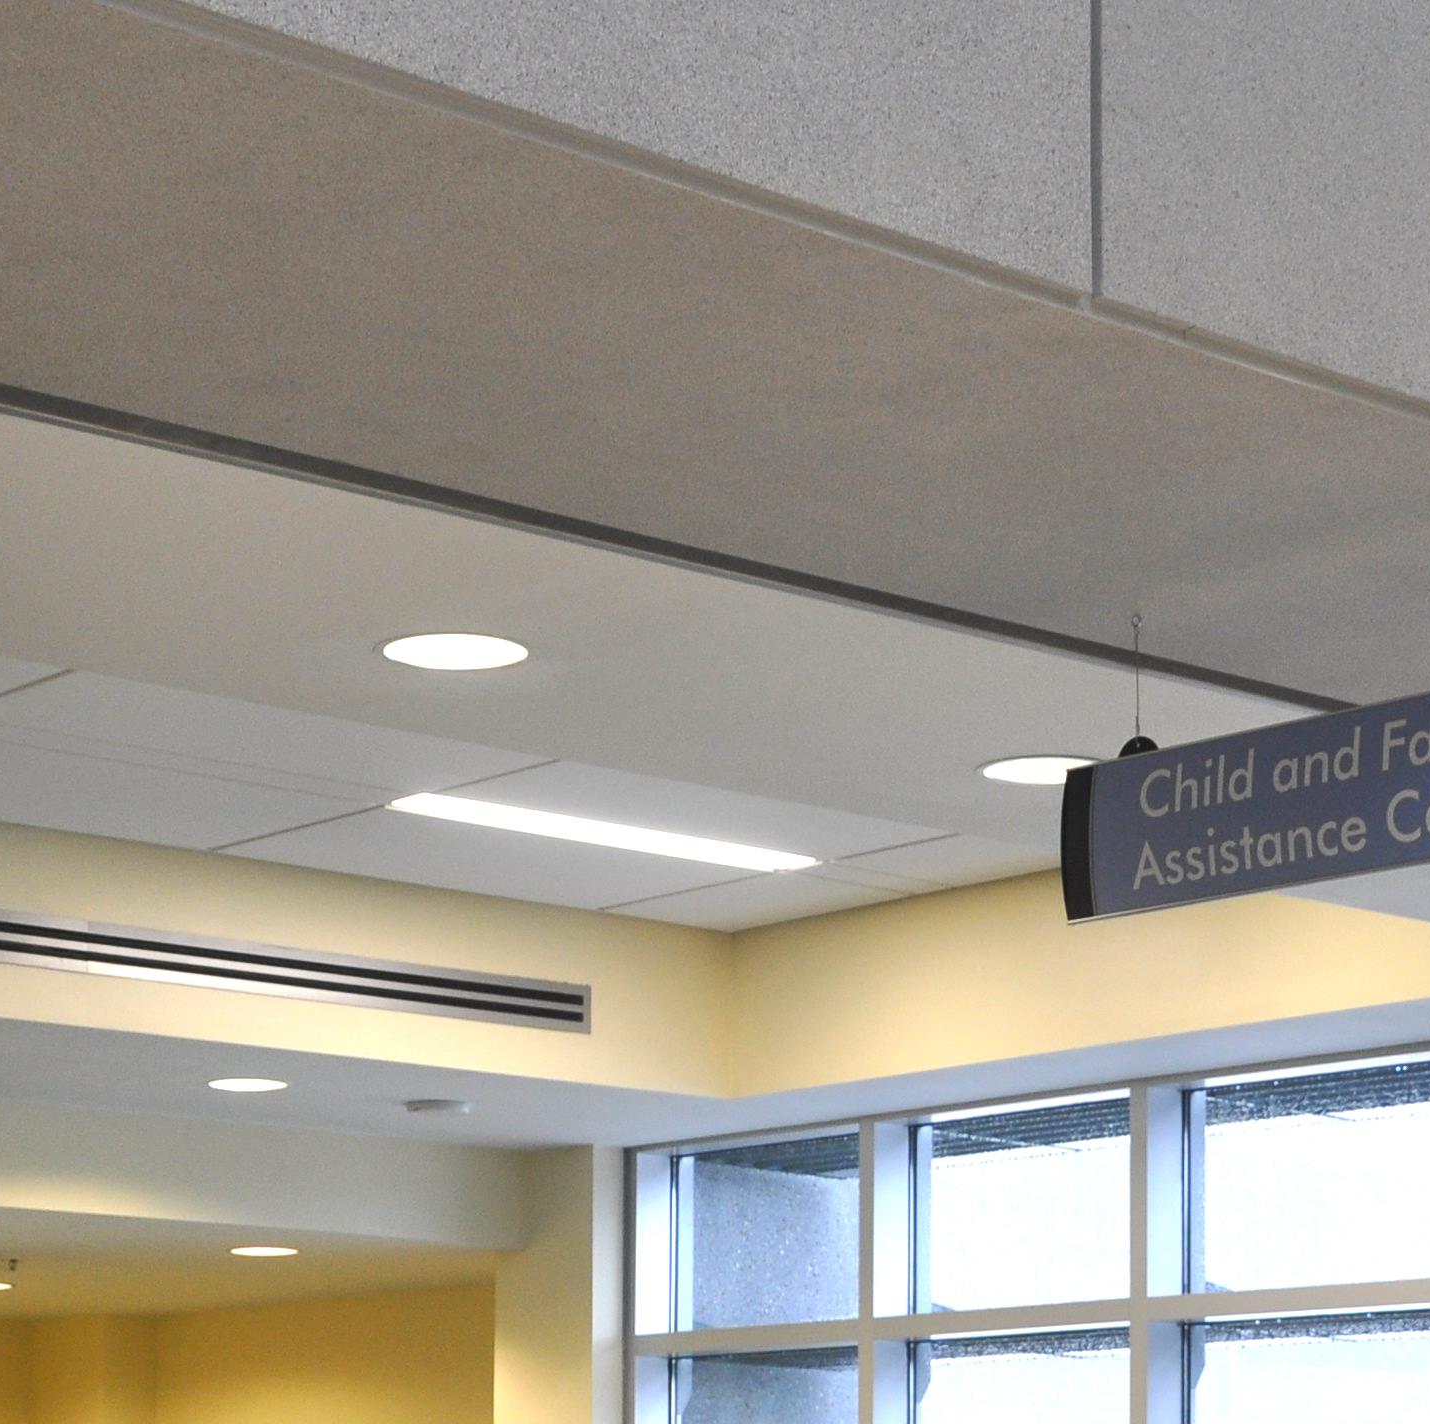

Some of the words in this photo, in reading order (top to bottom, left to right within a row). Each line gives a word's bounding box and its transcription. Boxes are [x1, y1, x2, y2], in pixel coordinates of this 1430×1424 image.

[1139, 749, 1254, 818] Child
[1272, 726, 1361, 794] and
[1132, 816, 1367, 891] Assistance
